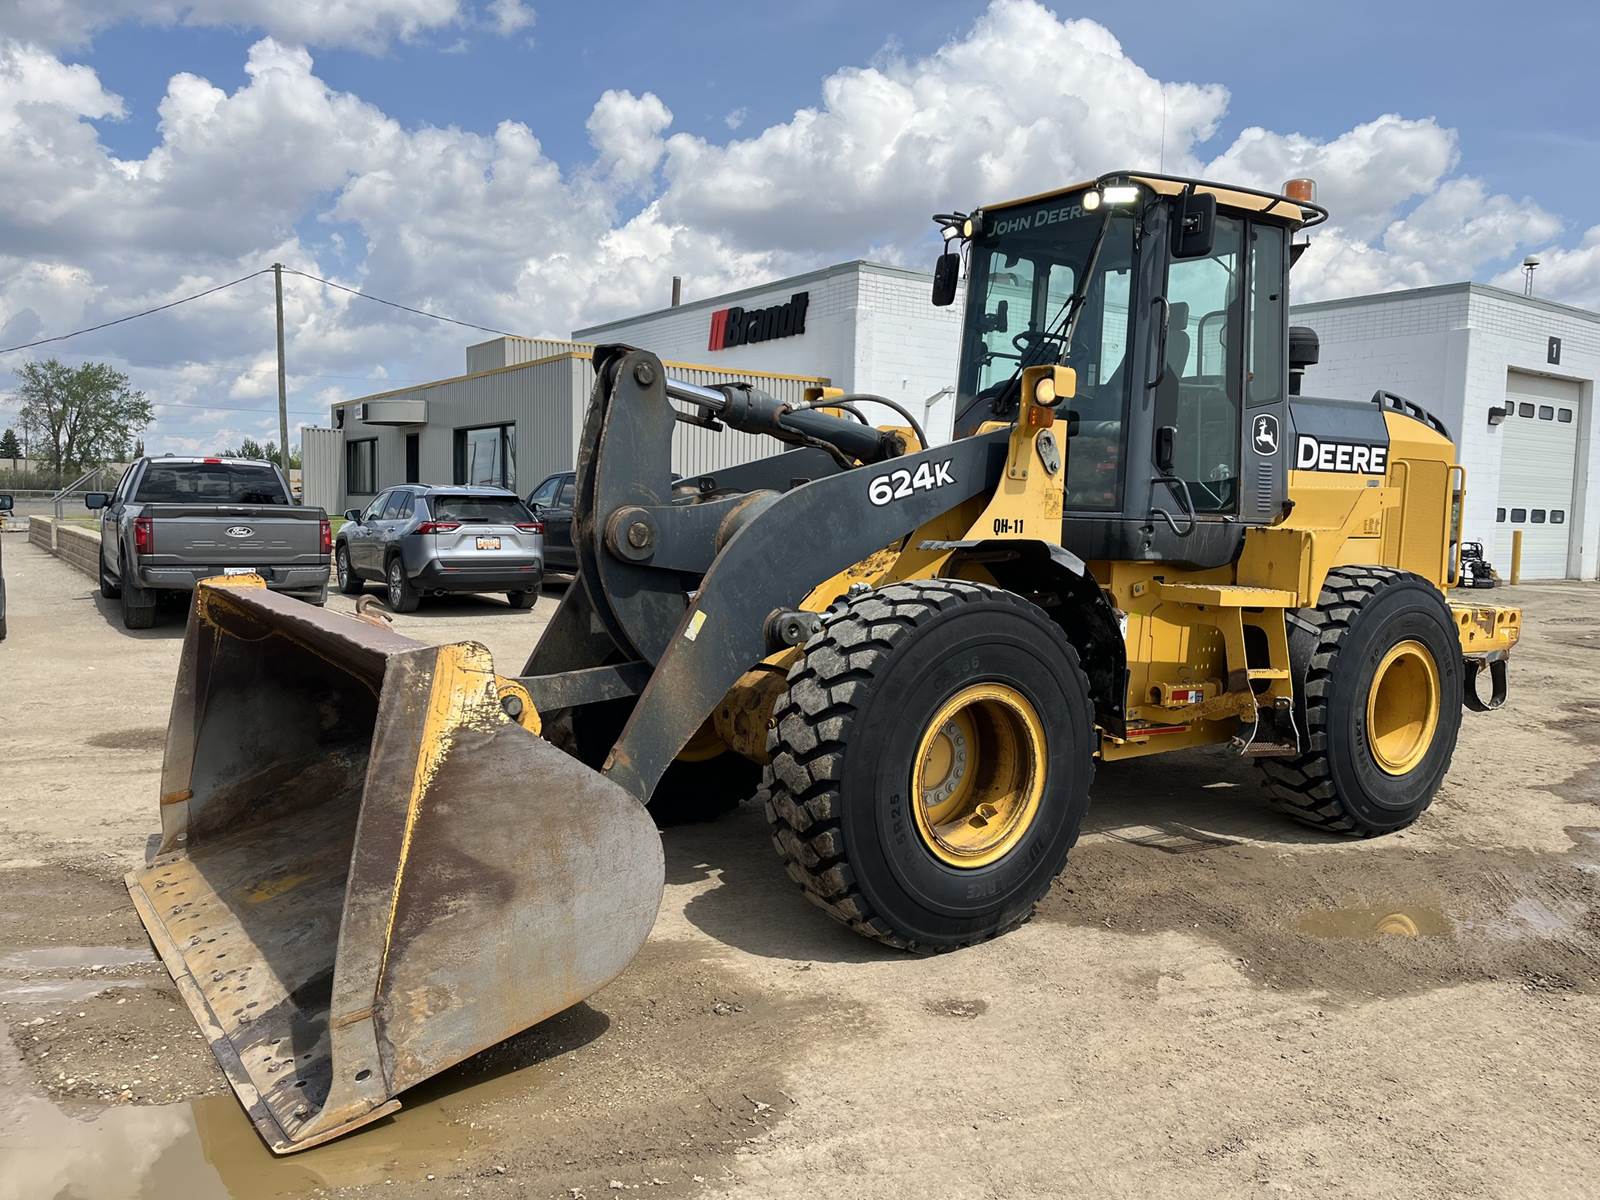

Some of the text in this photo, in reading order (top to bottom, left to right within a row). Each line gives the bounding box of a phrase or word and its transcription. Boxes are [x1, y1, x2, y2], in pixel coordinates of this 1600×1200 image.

[987, 215, 1031, 238] JOHN
[723, 291, 809, 349] Brandt
[1552, 343, 1557, 358] 1
[1296, 435, 1387, 473] DEERE
[868, 460, 956, 506] 624K
[993, 518, 1024, 536] QH-11
